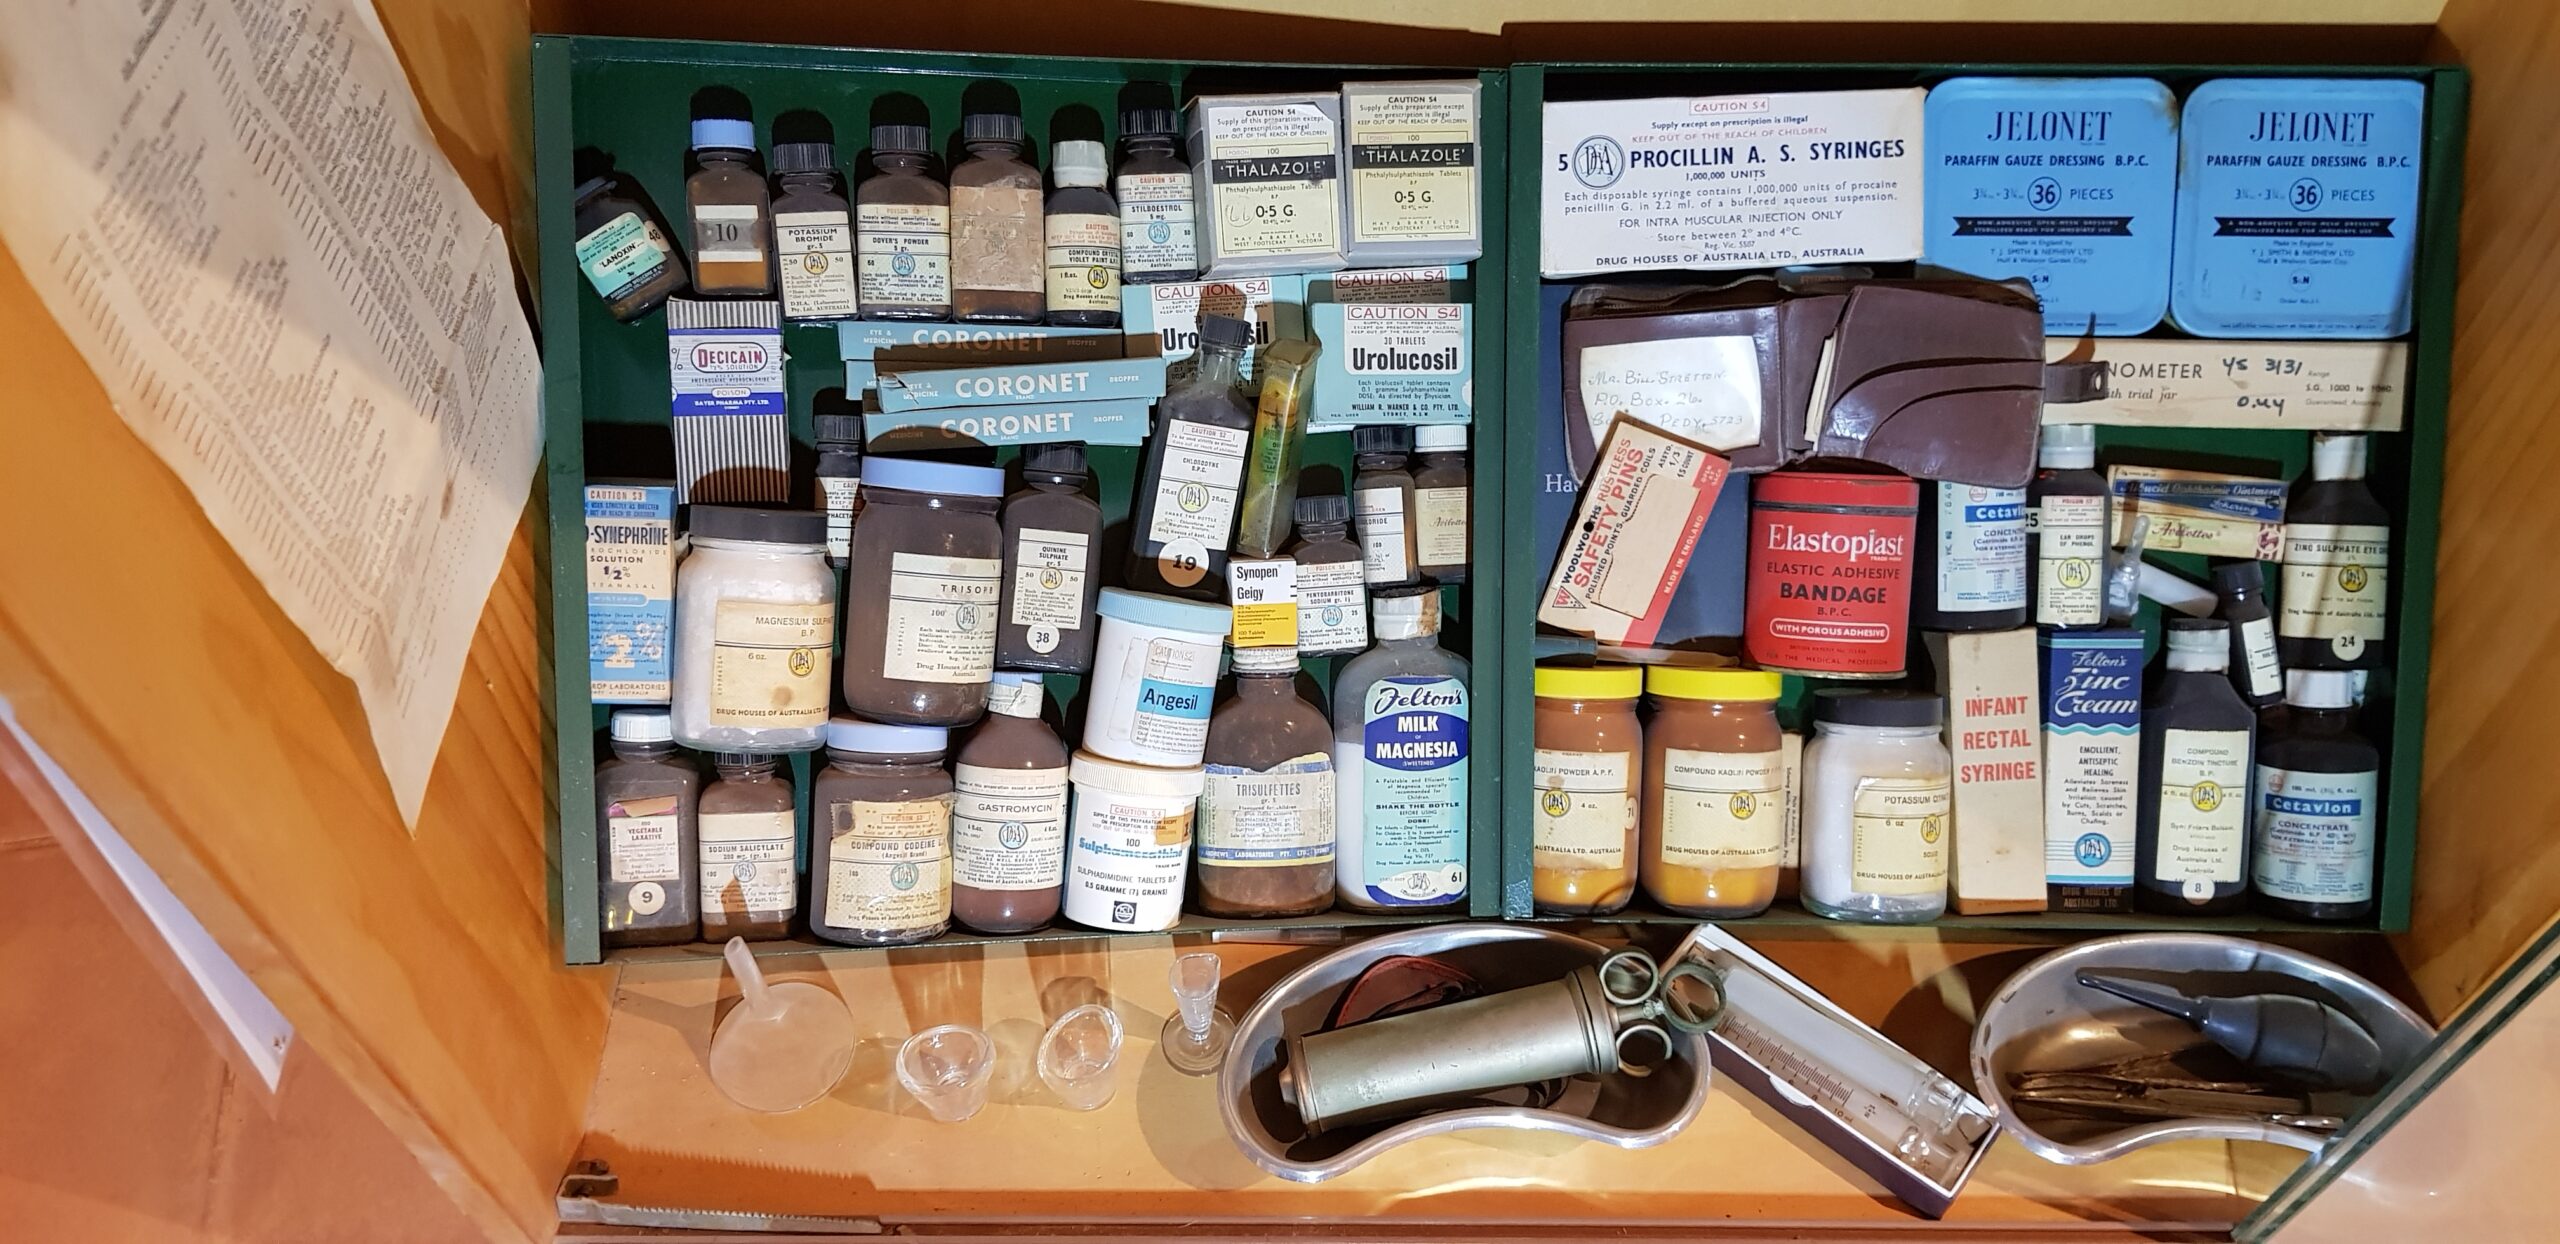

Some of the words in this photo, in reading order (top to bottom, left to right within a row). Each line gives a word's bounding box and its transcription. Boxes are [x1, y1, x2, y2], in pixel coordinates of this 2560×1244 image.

[1246, 109, 1283, 117] CAUTION
[1694, 102, 1748, 113] CAUTION
[1385, 112, 1423, 120] prescription
[1652, 121, 1678, 130] Supply
[1681, 120, 1709, 129] except
[1723, 118, 1772, 127] prescription
[1783, 115, 1808, 124] illegal
[1779, 128, 1827, 137] CHILDREN
[1987, 111, 2112, 141] JELONET
[2249, 111, 2374, 143] JELONET
[1361, 149, 1465, 163] 'THALAZOLE'
[1631, 147, 1733, 168] PROCILLIN
[1748, 146, 1766, 164] A.
[1780, 144, 1796, 161] S.
[1810, 140, 1905, 161] SYRINGES
[1945, 155, 1999, 166] PARAFFIN
[2005, 155, 2043, 166] GAUZE
[2050, 155, 2105, 166] DRESSING
[2115, 155, 2149, 166] B.P.C.
[2206, 154, 2262, 167] PARAFFIN
[2267, 154, 2305, 168] GAUZE
[2311, 154, 2367, 168] DRESSING
[2377, 154, 2411, 168] B.P.C.
[1221, 161, 1326, 178] 'THALAZOLE'
[1559, 154, 1568, 172] 5
[1686, 171, 1725, 182] 1,000,000
[1731, 169, 1765, 179] UNITS
[1565, 191, 1589, 201] Each
[1593, 190, 1648, 201] disposable
[1652, 188, 1691, 200] syringe
[1697, 186, 1741, 197] contains
[1748, 183, 1797, 195] 1,000,000
[1803, 182, 1831, 192] units
[1851, 179, 1897, 191] procaine
[2033, 184, 2056, 204] 36
[2070, 189, 2114, 200] PIECES
[2294, 185, 2317, 205] 36
[2331, 189, 2375, 201] PIECES
[1565, 202, 1616, 215] penicillin
[1731, 196, 1776, 207] buffered
[1784, 195, 1827, 206] aqueous
[1835, 192, 1897, 203] suspension.
[1619, 218, 1640, 228] FOR
[1646, 216, 1679, 227] INTRA
[1685, 213, 1742, 226] MUSCULAR
[1748, 211, 1805, 223] INJECTION
[1812, 210, 1843, 220] ONLY
[649, 229, 660, 241] 48
[715, 224, 737, 242] 10
[789, 228, 837, 236] POTASSIUM
[1657, 232, 1686, 242] Store
[1691, 230, 1736, 240] between
[1757, 227, 1775, 237] and
[1597, 256, 1627, 266] DRUG
[1634, 255, 1680, 264] HOUSES
[1684, 253, 1698, 263] OF
[1703, 251, 1765, 262] AUSTRALIA
[1770, 250, 1797, 261] LTD.,
[1803, 247, 1864, 259] AUSTRALIA
[1339, 272, 1415, 288] CAUTION
[1158, 283, 1241, 299] CAUTION
[1351, 306, 1432, 319] CAUTION
[1437, 306, 1459, 319] S4
[913, 329, 1048, 352] CORONET
[1396, 336, 1426, 346] TABLETS
[697, 349, 762, 368] DECICAIN
[1353, 347, 1458, 370] Urolucosil
[955, 372, 1089, 398] CORONET
[716, 389, 747, 397] POISON
[2128, 388, 2153, 400] trial
[940, 412, 1074, 438] CORONET
[1597, 438, 1631, 502] RUSTLESS
[590, 490, 629, 499] CAUTION
[1574, 504, 1618, 588] SAFETY
[1611, 449, 1643, 500] PINS
[1586, 558, 1607, 599] POLISHED
[1621, 477, 1643, 518] GUARDED
[1640, 447, 1656, 473] COILS
[1768, 523, 1904, 562] Elastoplast
[2317, 545, 2360, 553] SULPHATE
[1039, 552, 1069, 561] SULPHATE
[1042, 546, 1067, 554] QUININE
[1664, 572, 1677, 594] MADE
[1681, 515, 1703, 556] ENGLAND
[590, 556, 643, 564] SOLUTION
[1172, 553, 1197, 572] 19
[1236, 566, 1278, 582] Synopen
[1767, 562, 1825, 579] ELASTIC
[1832, 564, 1901, 580] ADHESIVE
[1236, 586, 1264, 602] Geigy
[1780, 582, 1887, 604] BANDAGE
[1310, 597, 1335, 605] SODIUM
[1817, 607, 1852, 617] B.P.C.
[755, 617, 809, 626] MAGNESIUM
[1036, 632, 1050, 644] 38
[1775, 624, 1796, 634] WITH
[1799, 626, 1842, 637] POROUS
[1843, 627, 1886, 638] ADHESIVE
[2341, 636, 2355, 647] 24
[2071, 651, 2127, 668] Felton's
[610, 682, 666, 691] LABORATORIES
[2055, 668, 2131, 696] Zinc
[1143, 688, 1198, 711] Angesil
[1374, 687, 1462, 715] Felton's
[2054, 690, 2138, 717] Cream
[778, 707, 812, 716] AUSTRALIA
[1965, 696, 2028, 718] INFANT
[1398, 716, 1438, 733] MILK
[1962, 730, 2032, 751] RECTAL
[1376, 741, 1458, 759] MAGNESIA
[2187, 748, 2229, 756] COMPOUND
[2078, 758, 2118, 766] ANTISEPTIC
[2171, 758, 2204, 766] BENZOIN
[1558, 767, 1591, 776] POWDER
[1674, 765, 1715, 775] COMPOUND
[1960, 761, 2037, 784] SYRINGE
[2084, 769, 2114, 777] HEALING
[1236, 783, 1301, 796] TRISULFETTES
[1884, 795, 1931, 805] POTASSIUM
[2273, 798, 2351, 814] Cetavlon
[978, 803, 1052, 812] GASTROMYCIN
[1115, 807, 1148, 816] CAUTION
[628, 827, 663, 835] VEGETABLE
[2278, 820, 2349, 831] CONCENTRATE
[740, 843, 784, 851] SALICYLATE
[851, 841, 899, 851] COMPOUND
[904, 840, 936, 850] CODEINE
[1126, 838, 1140, 847] 100
[1589, 846, 1621, 854] AUSTRALIA
[1077, 866, 1133, 883] SULPHADIMIDINE
[1451, 871, 1462, 883] 61
[1096, 882, 1126, 895] GRAMME
[2195, 882, 2201, 893] 8
[642, 891, 652, 903] 9
